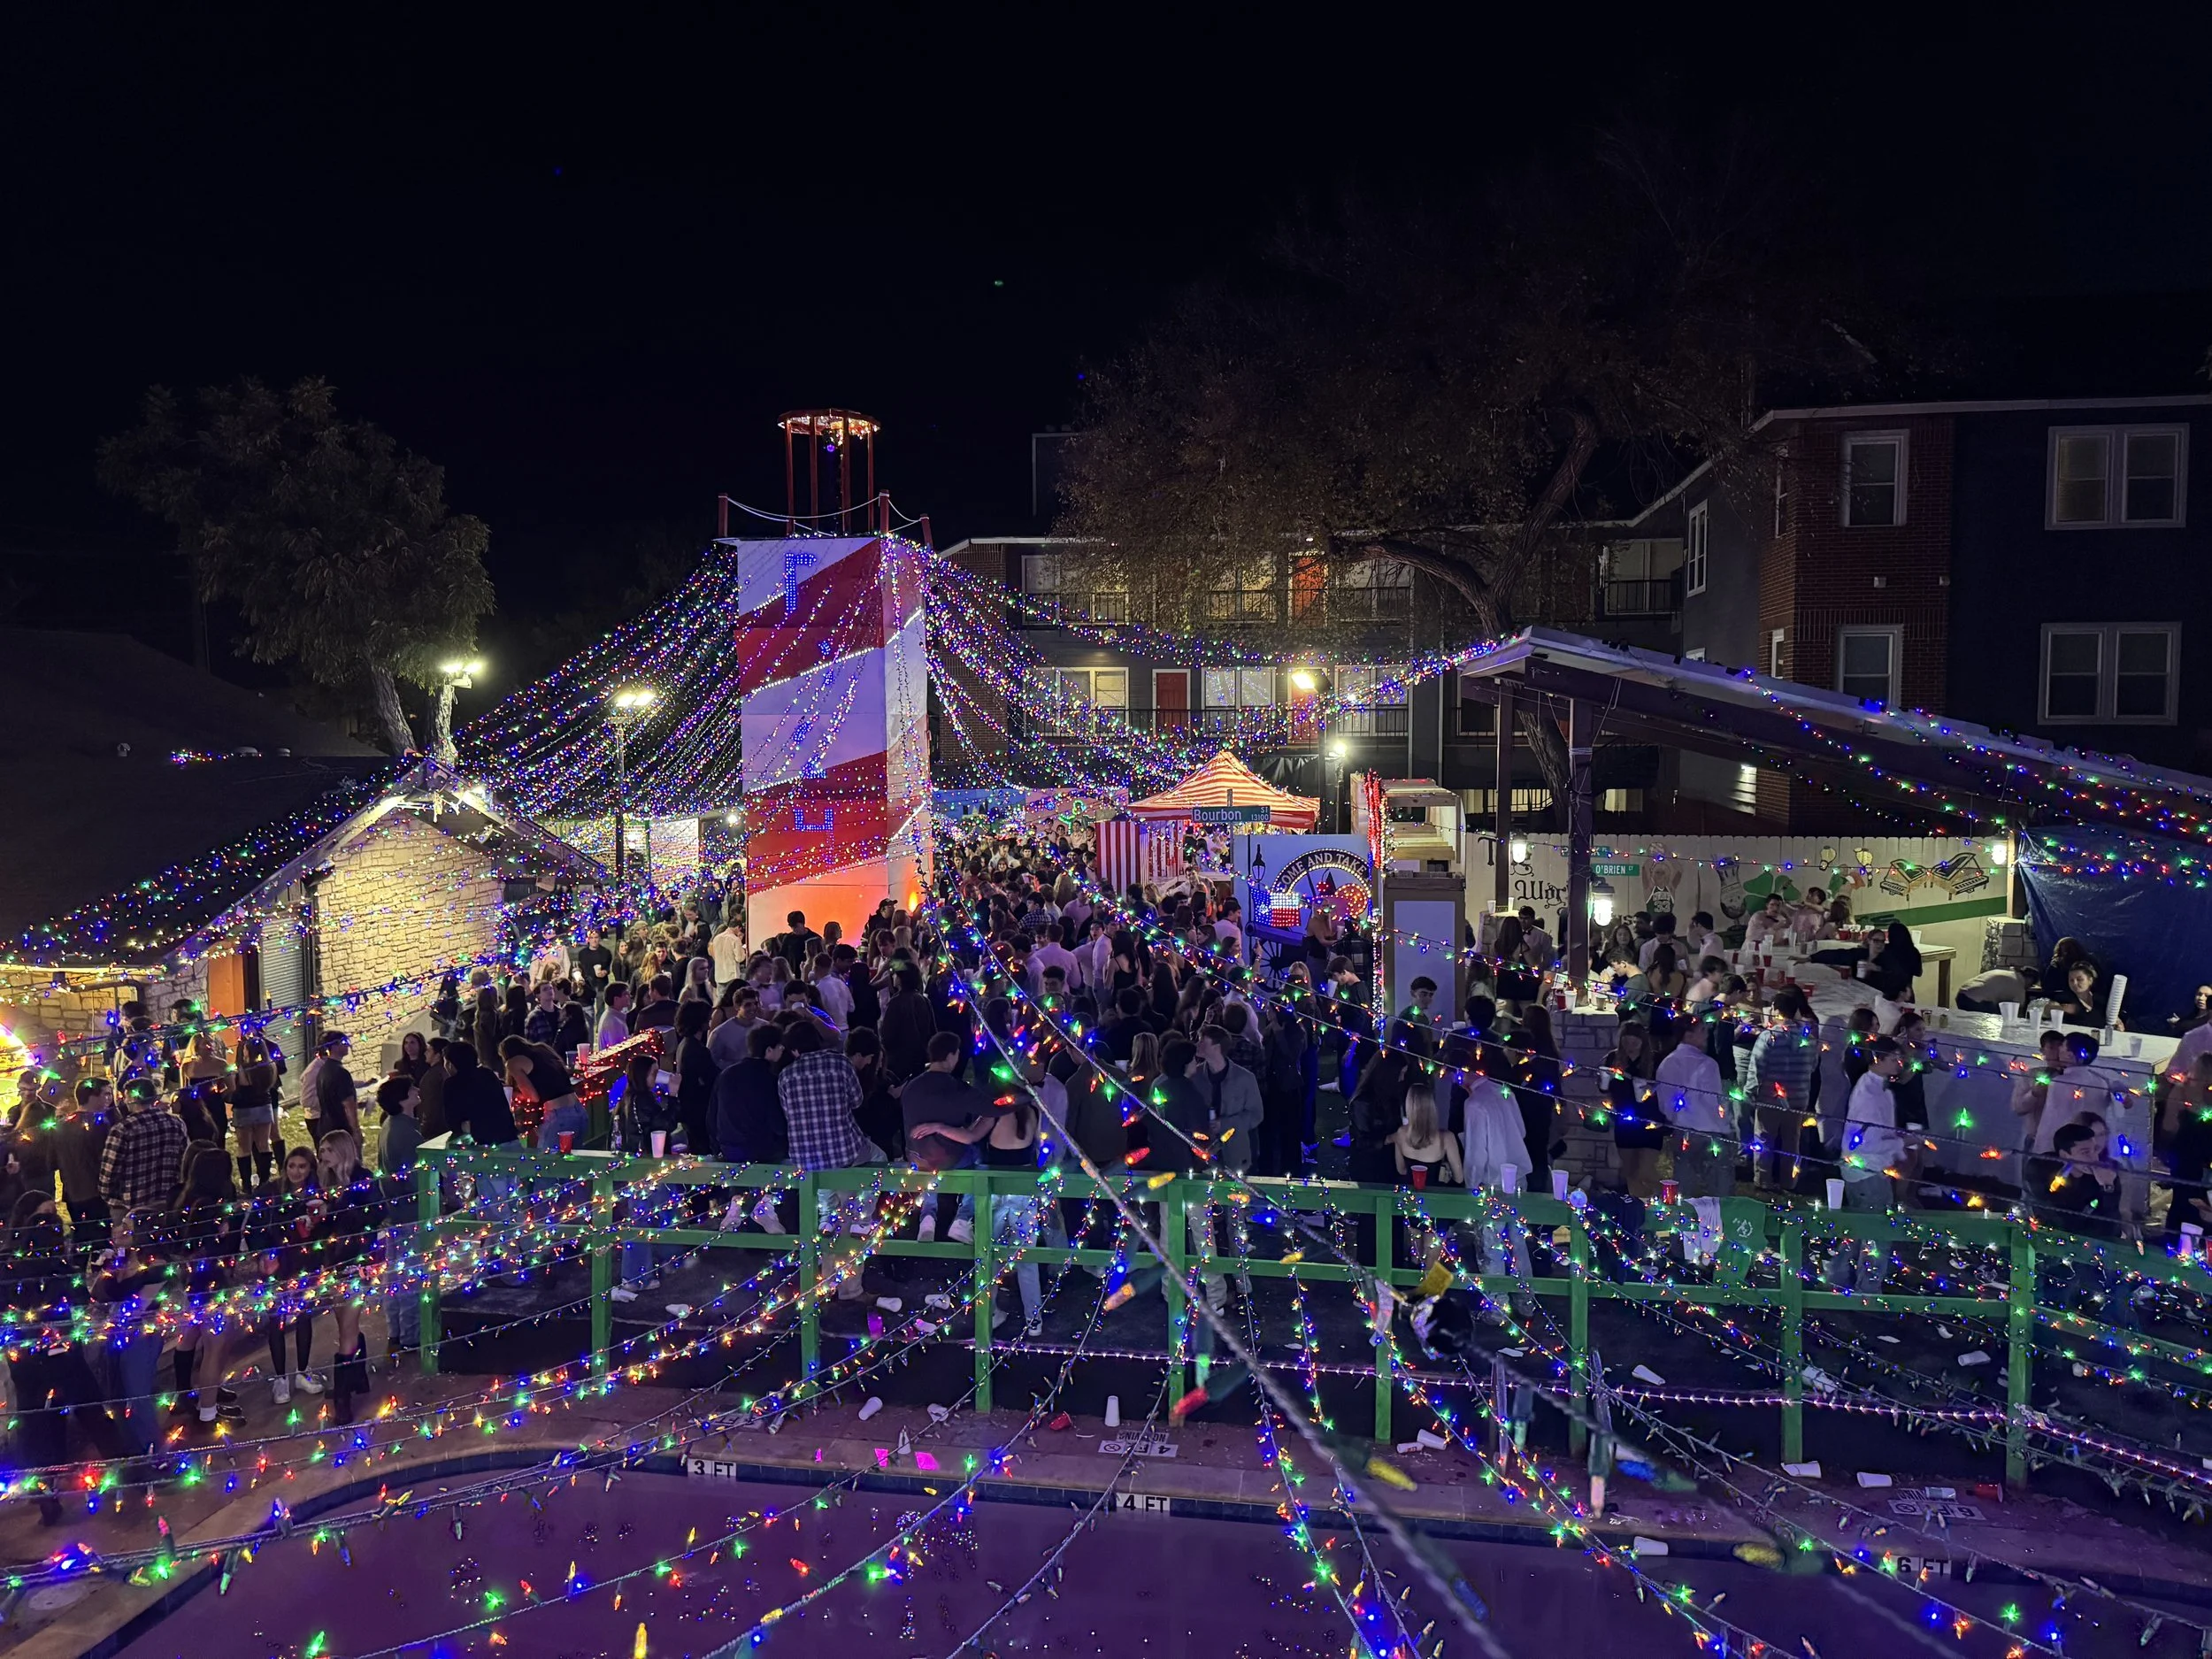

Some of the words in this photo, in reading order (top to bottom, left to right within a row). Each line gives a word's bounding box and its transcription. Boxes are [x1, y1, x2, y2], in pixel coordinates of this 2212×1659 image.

[1194, 809, 1241, 821] Bourbon
[1278, 861, 1305, 888] OME
[1308, 852, 1333, 867] AND
[1336, 853, 1367, 875] TAKE
[1595, 864, 1626, 874] O'BRIEN
[694, 1460, 705, 1475] 3
[714, 1462, 733, 1478] FT
[1123, 1494, 1136, 1510] 4
[1145, 1496, 1167, 1513] FT
[1897, 1556, 1911, 1572] 6
[1924, 1558, 1951, 1576] FT
